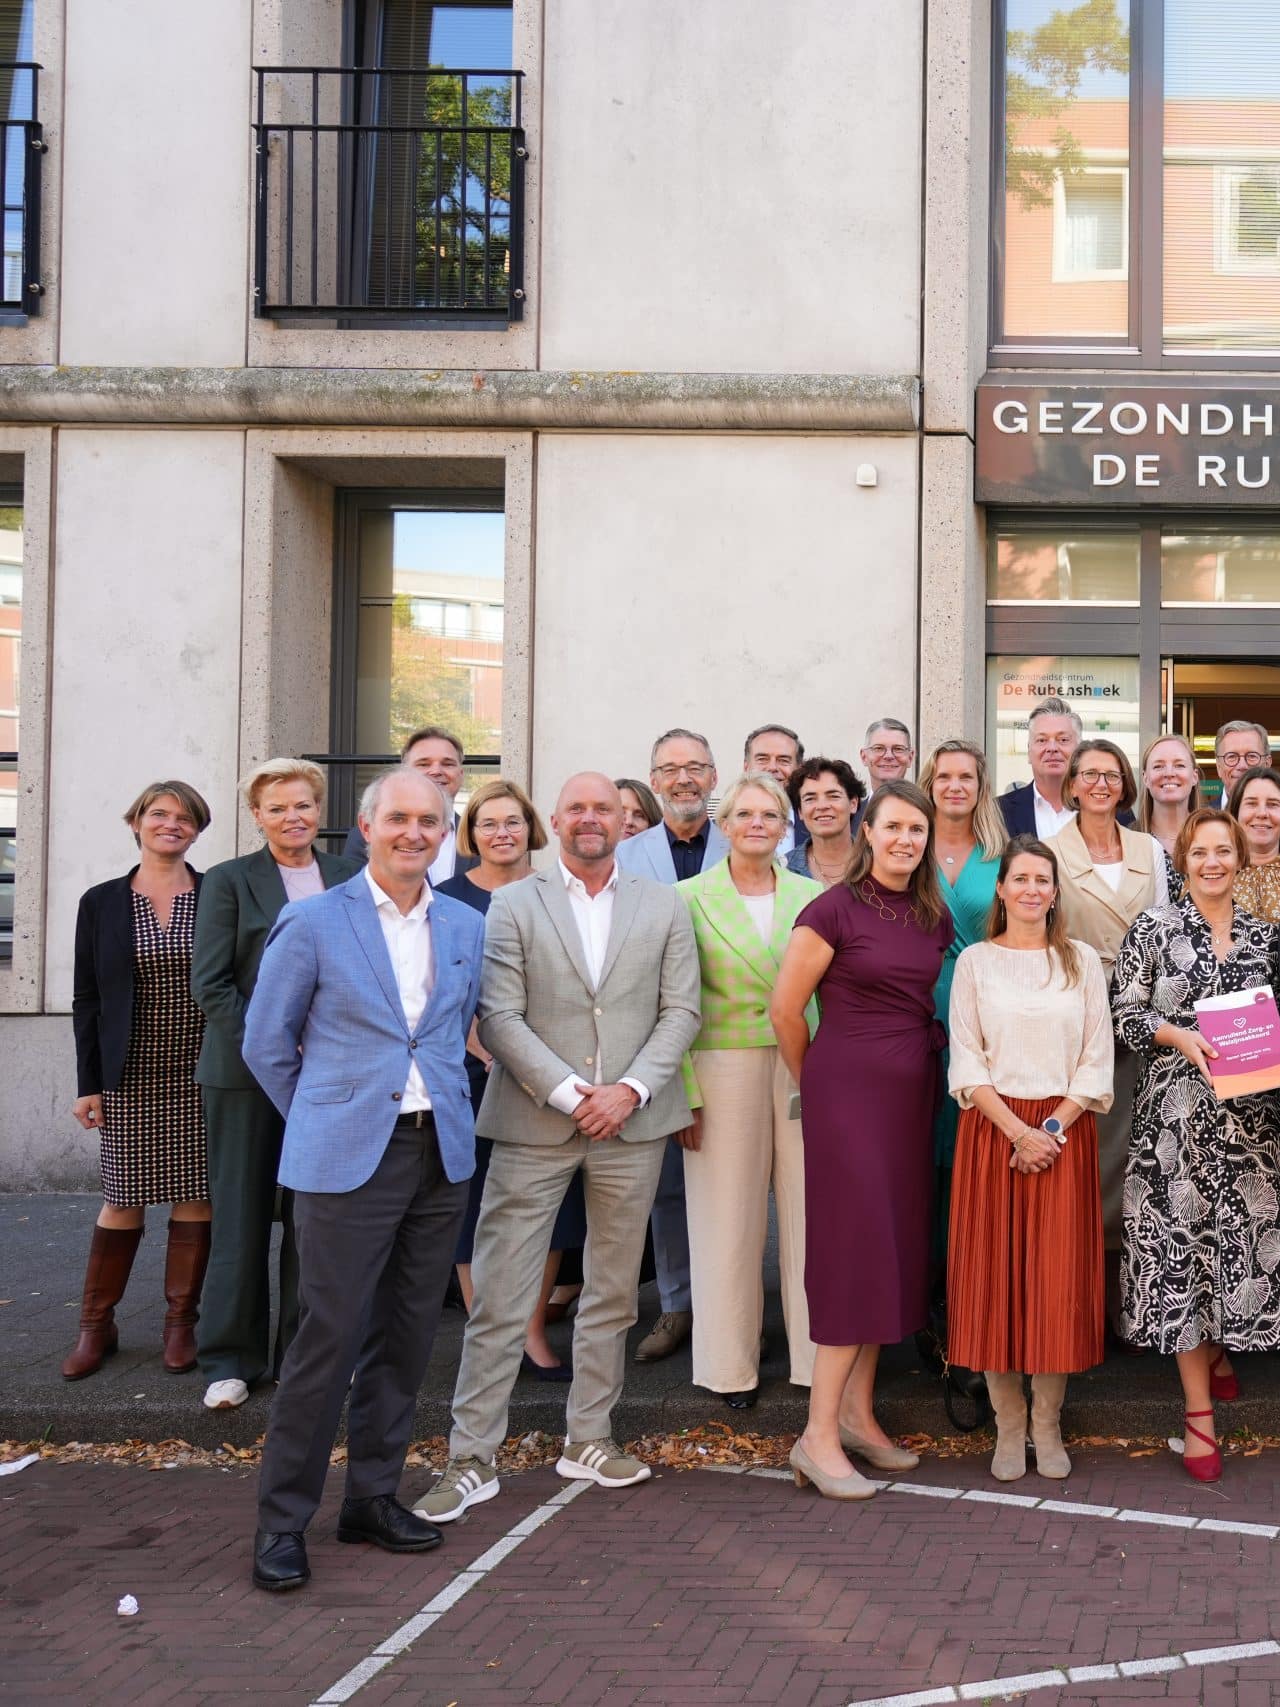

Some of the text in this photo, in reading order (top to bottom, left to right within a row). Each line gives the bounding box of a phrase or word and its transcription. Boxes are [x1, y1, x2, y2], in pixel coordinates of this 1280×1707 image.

[1092, 454, 1160, 487] DE
[1003, 672, 1094, 681] Gezondheidscentrum
[1003, 684, 1023, 696] De
